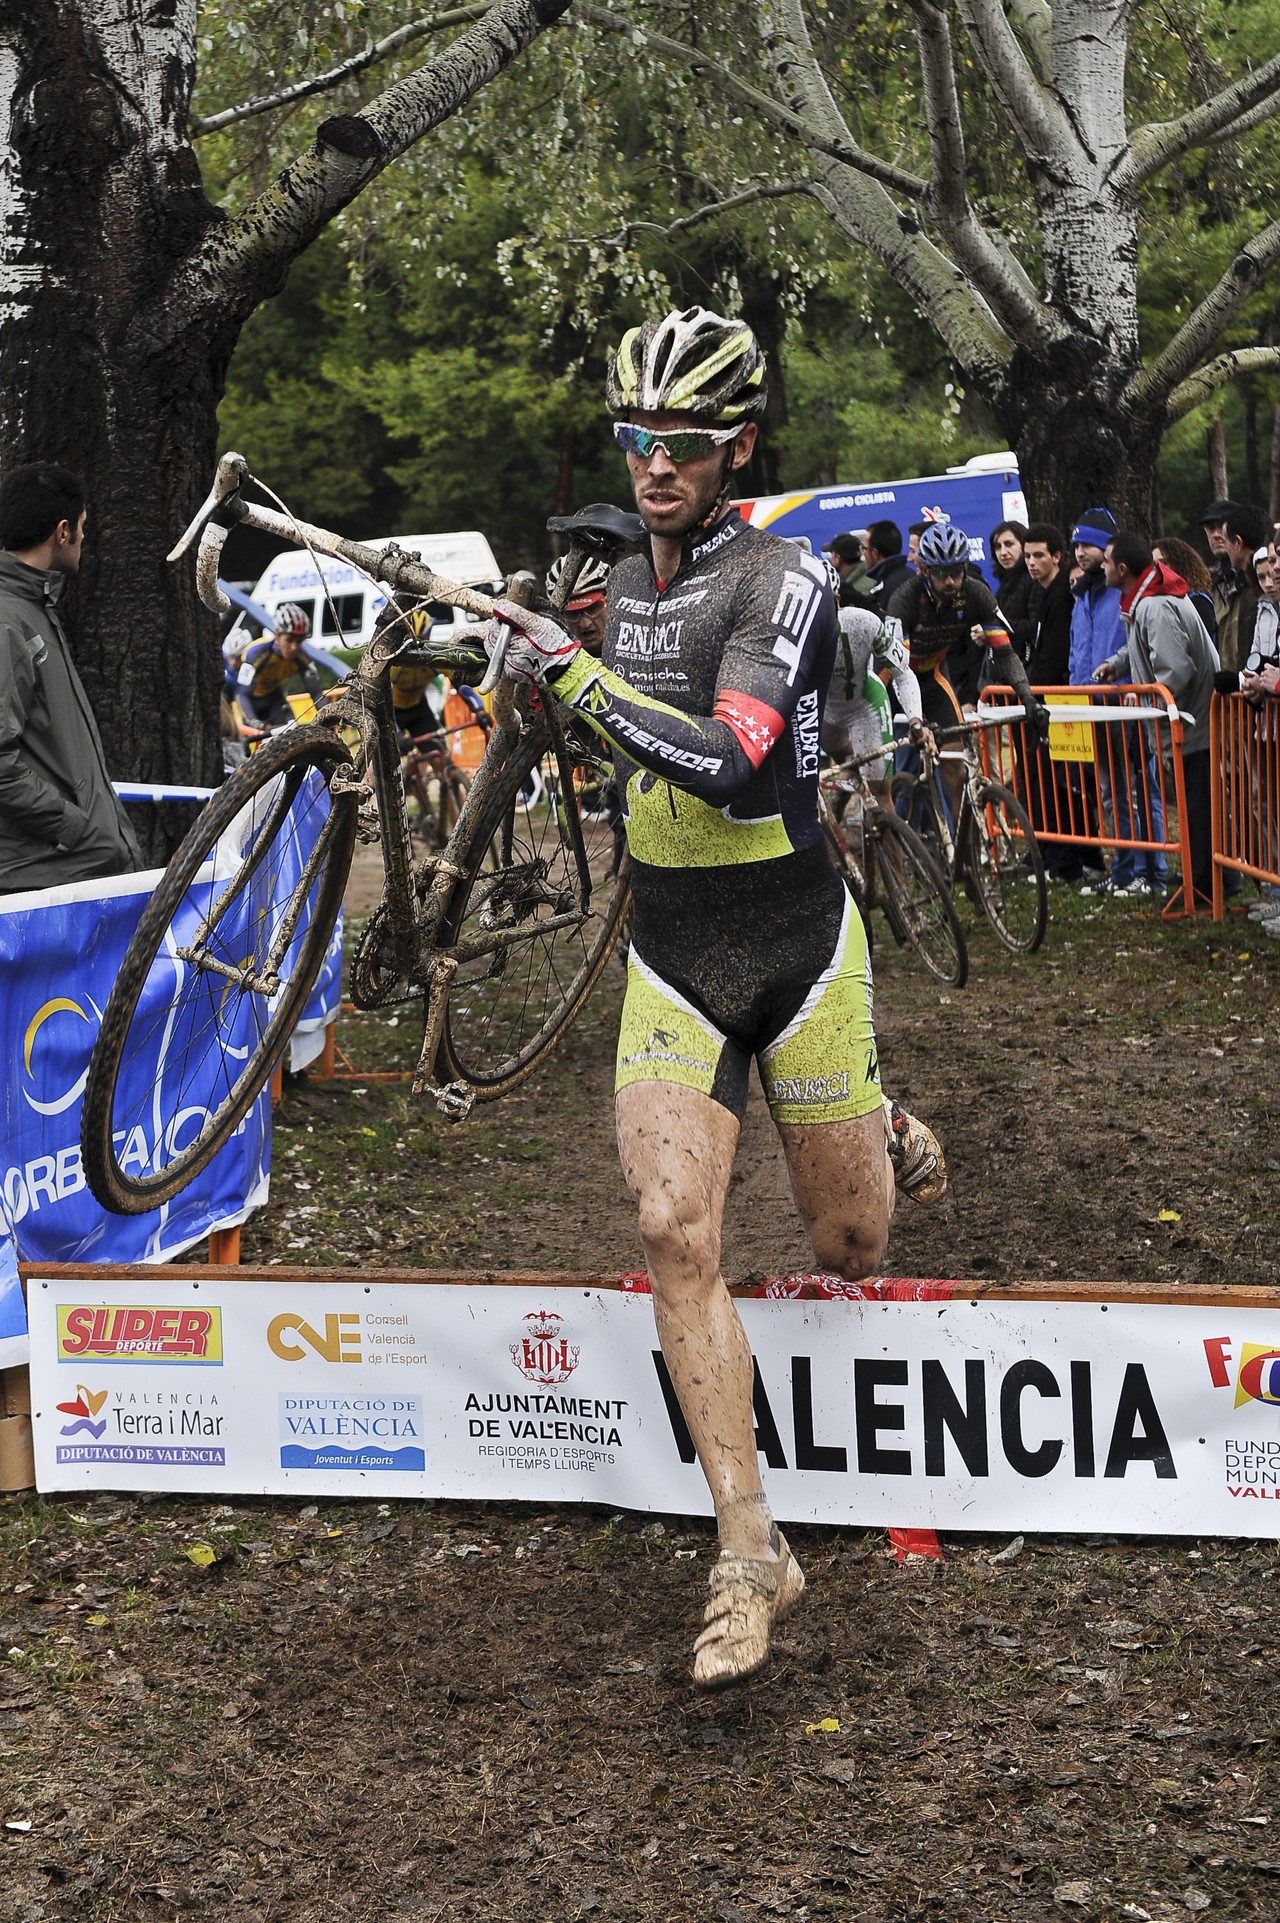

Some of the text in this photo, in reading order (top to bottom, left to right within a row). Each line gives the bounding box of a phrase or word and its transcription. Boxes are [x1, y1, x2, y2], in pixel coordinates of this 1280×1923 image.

[605, 712, 723, 776] MERIDA
[366, 1314, 408, 1325] Consell
[62, 1308, 211, 1356] SUPER
[367, 1333, 416, 1345] Valencià
[116, 1341, 163, 1351] DEPORTE
[368, 1353, 382, 1363] de
[116, 1392, 218, 1405] VALENCIA
[285, 1399, 416, 1411] DIPUTACIÓ DE
[464, 1393, 628, 1419] AJUNTAMENT
[113, 1408, 223, 1435] Terra i Mar
[286, 1414, 418, 1436] VALÈNCIA
[469, 1419, 622, 1447] DE VALENCIA
[60, 1447, 223, 1462] DIPUTACIÓ DE VALÈNCIA
[478, 1445, 547, 1457] REGIDORIA
[315, 1454, 352, 1465] Joventut
[360, 1455, 394, 1466] Esports
[508, 1458, 550, 1470] TEMPS
[554, 1460, 596, 1472] LLIURE
